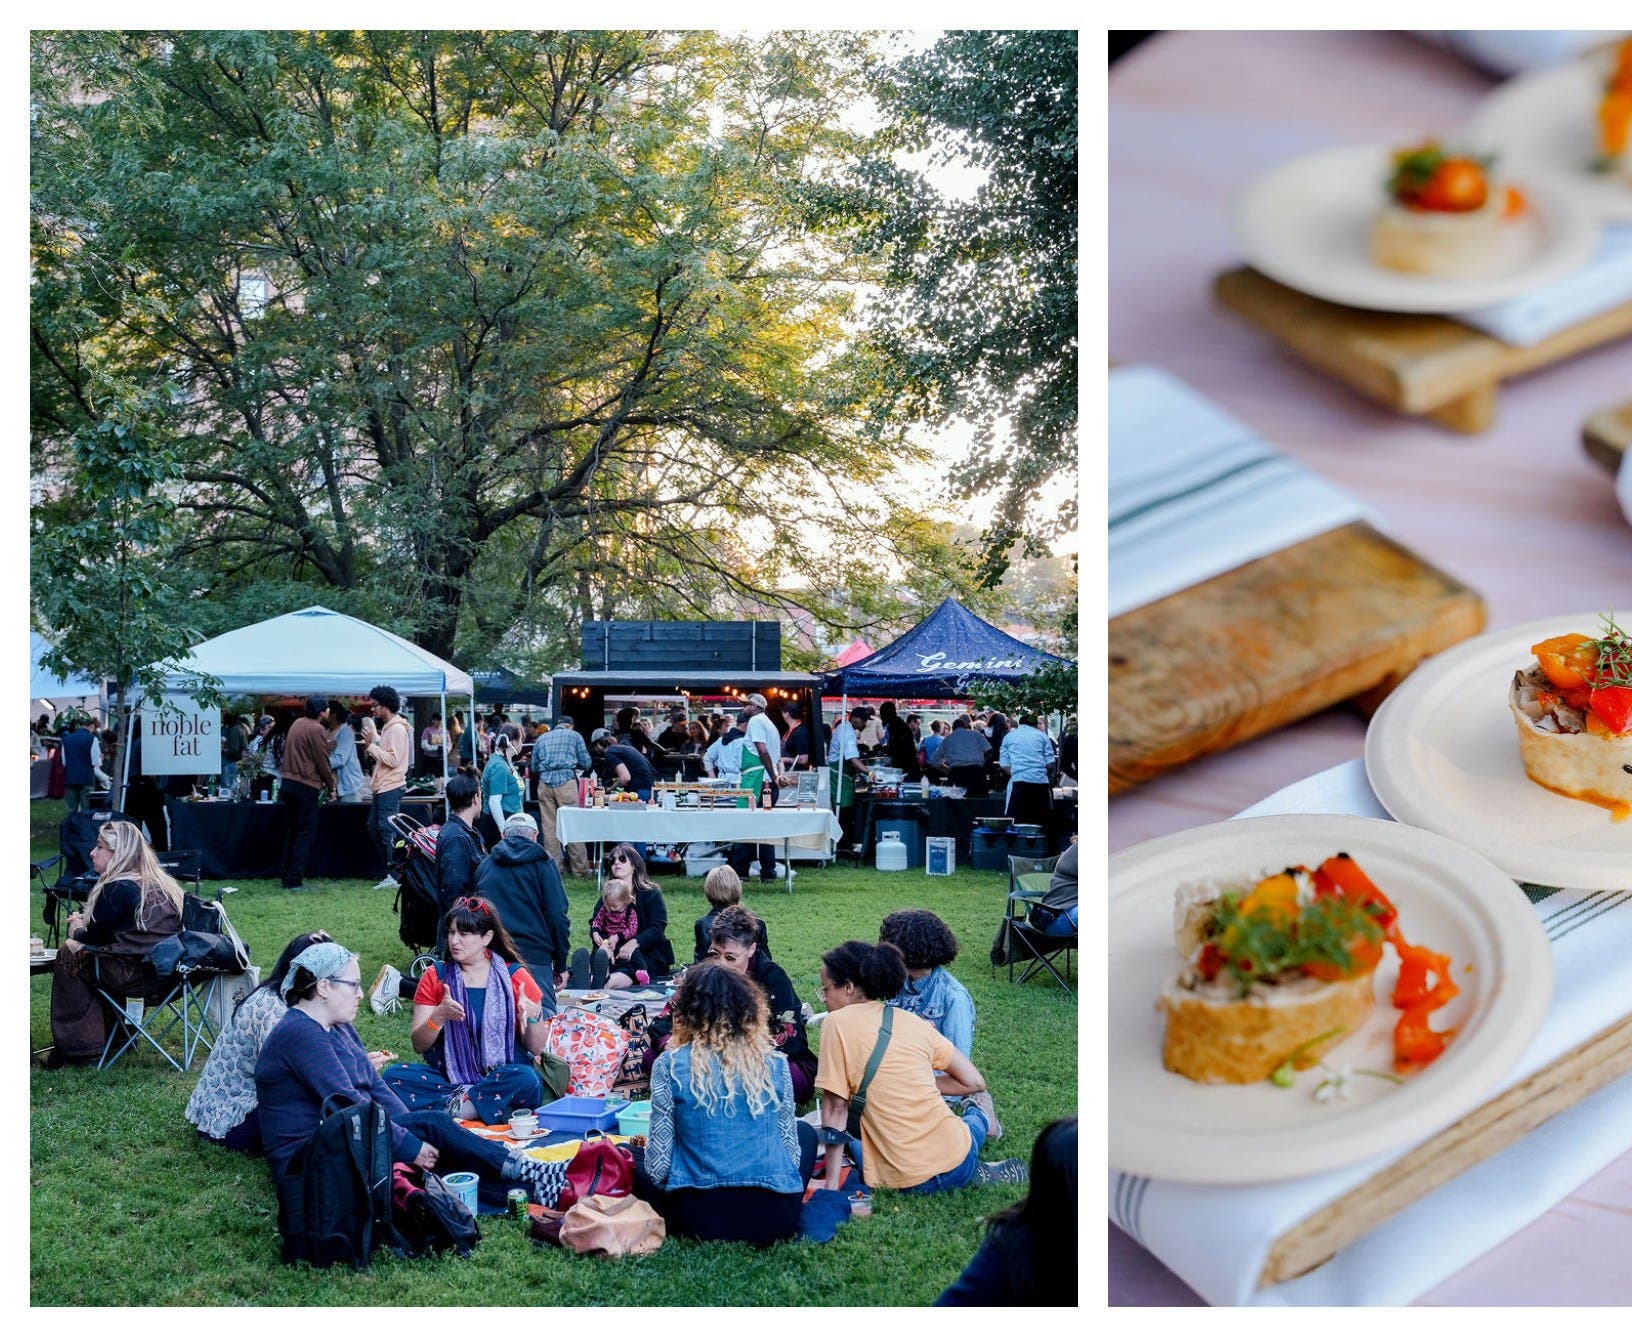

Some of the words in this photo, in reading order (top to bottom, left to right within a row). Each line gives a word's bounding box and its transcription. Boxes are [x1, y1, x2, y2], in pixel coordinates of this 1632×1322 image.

[914, 652, 1026, 673] Gemini
[151, 714, 212, 736] noble
[172, 735, 202, 757] fat
